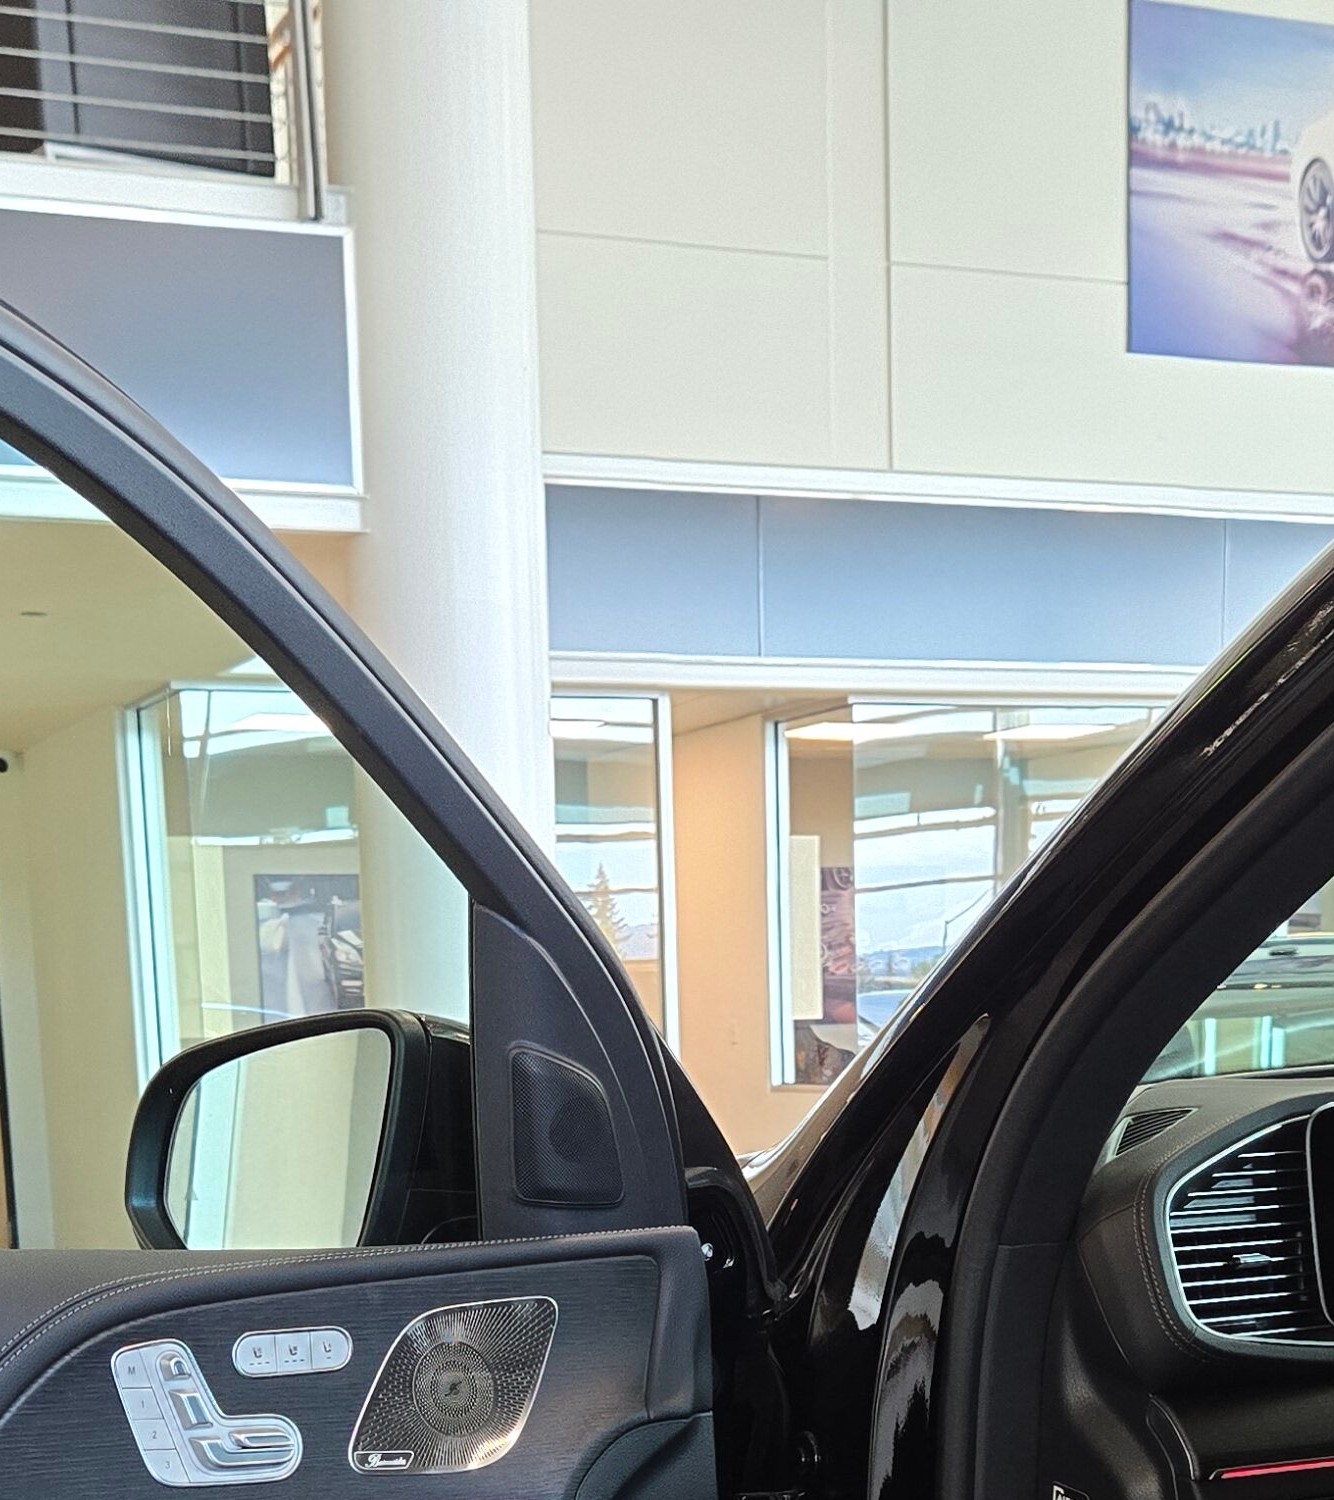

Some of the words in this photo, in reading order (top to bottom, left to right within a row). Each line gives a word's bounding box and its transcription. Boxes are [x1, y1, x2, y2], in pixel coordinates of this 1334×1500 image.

[128, 1366, 136, 1375] M
[152, 1430, 157, 1439] 2
[165, 1461, 170, 1469] 3
